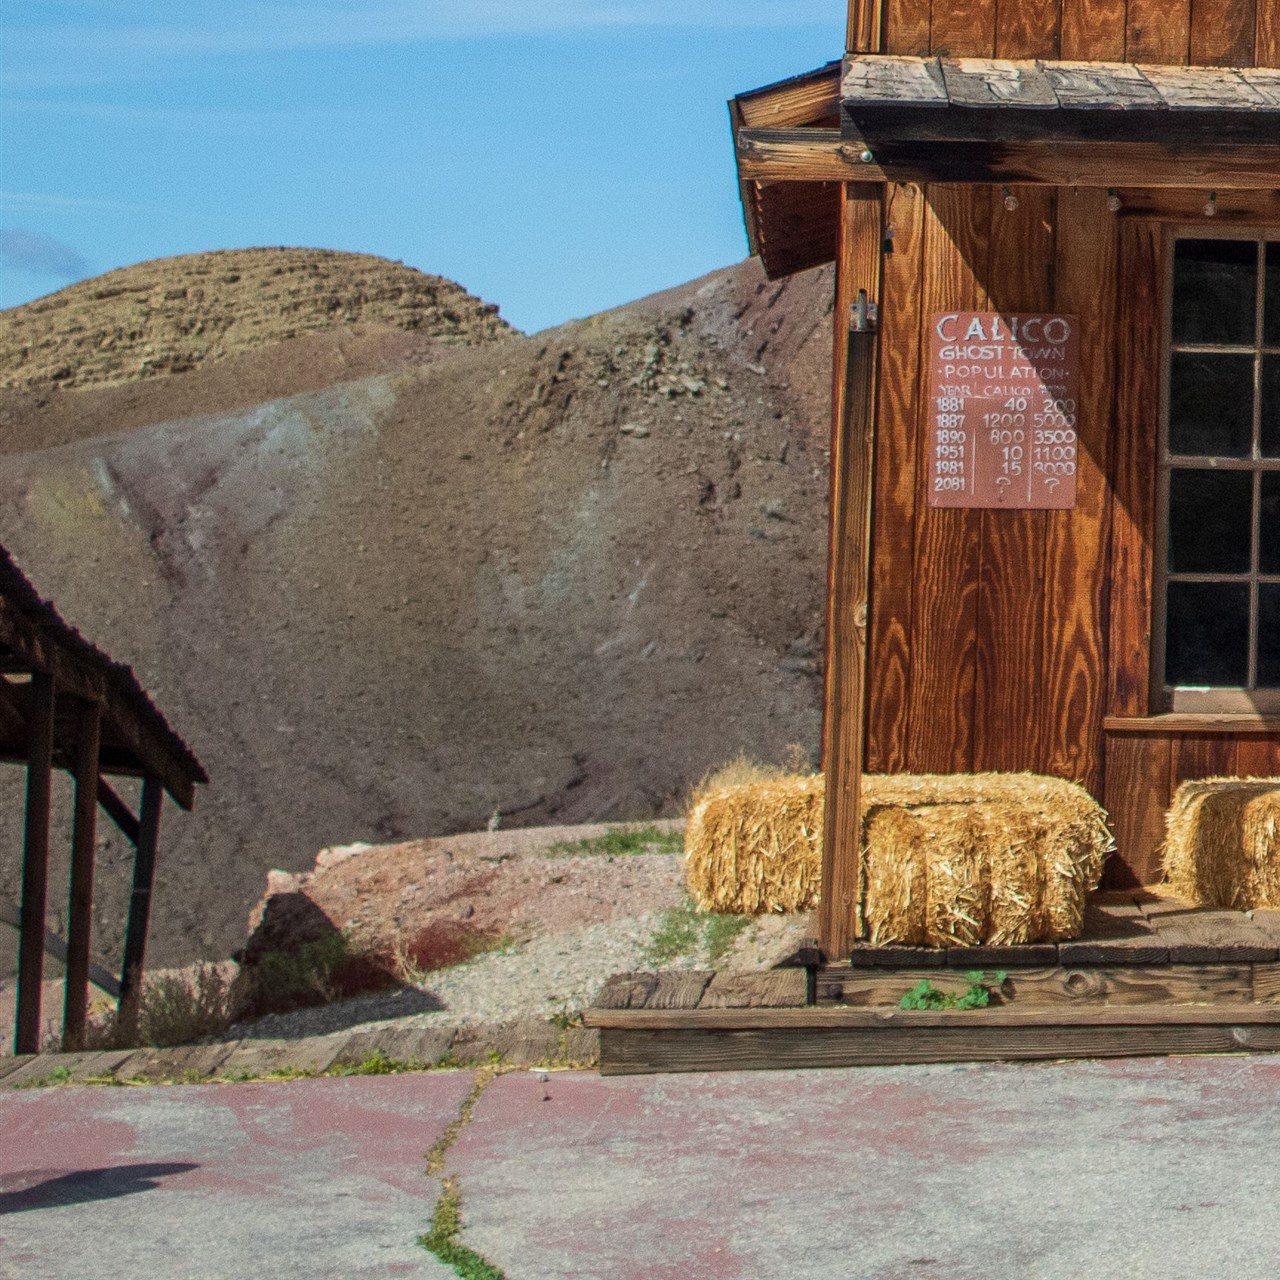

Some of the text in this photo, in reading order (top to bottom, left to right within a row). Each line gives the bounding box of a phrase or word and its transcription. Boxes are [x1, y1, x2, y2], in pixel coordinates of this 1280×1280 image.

[936, 314, 1071, 345] CALICO
[939, 345, 1066, 360] GHOST TOWN
[938, 383, 972, 396] YEAR
[983, 385, 1032, 397] CALICO
[935, 396, 1076, 414] 1881 40 200
[935, 413, 1077, 429] 1887 1200 5000
[935, 429, 1077, 445] 1890 800 3500
[935, 445, 1076, 461] 1951 10 1100
[935, 460, 965, 475] 1981
[1001, 461, 1023, 476] 15
[934, 477, 966, 491] 2081
